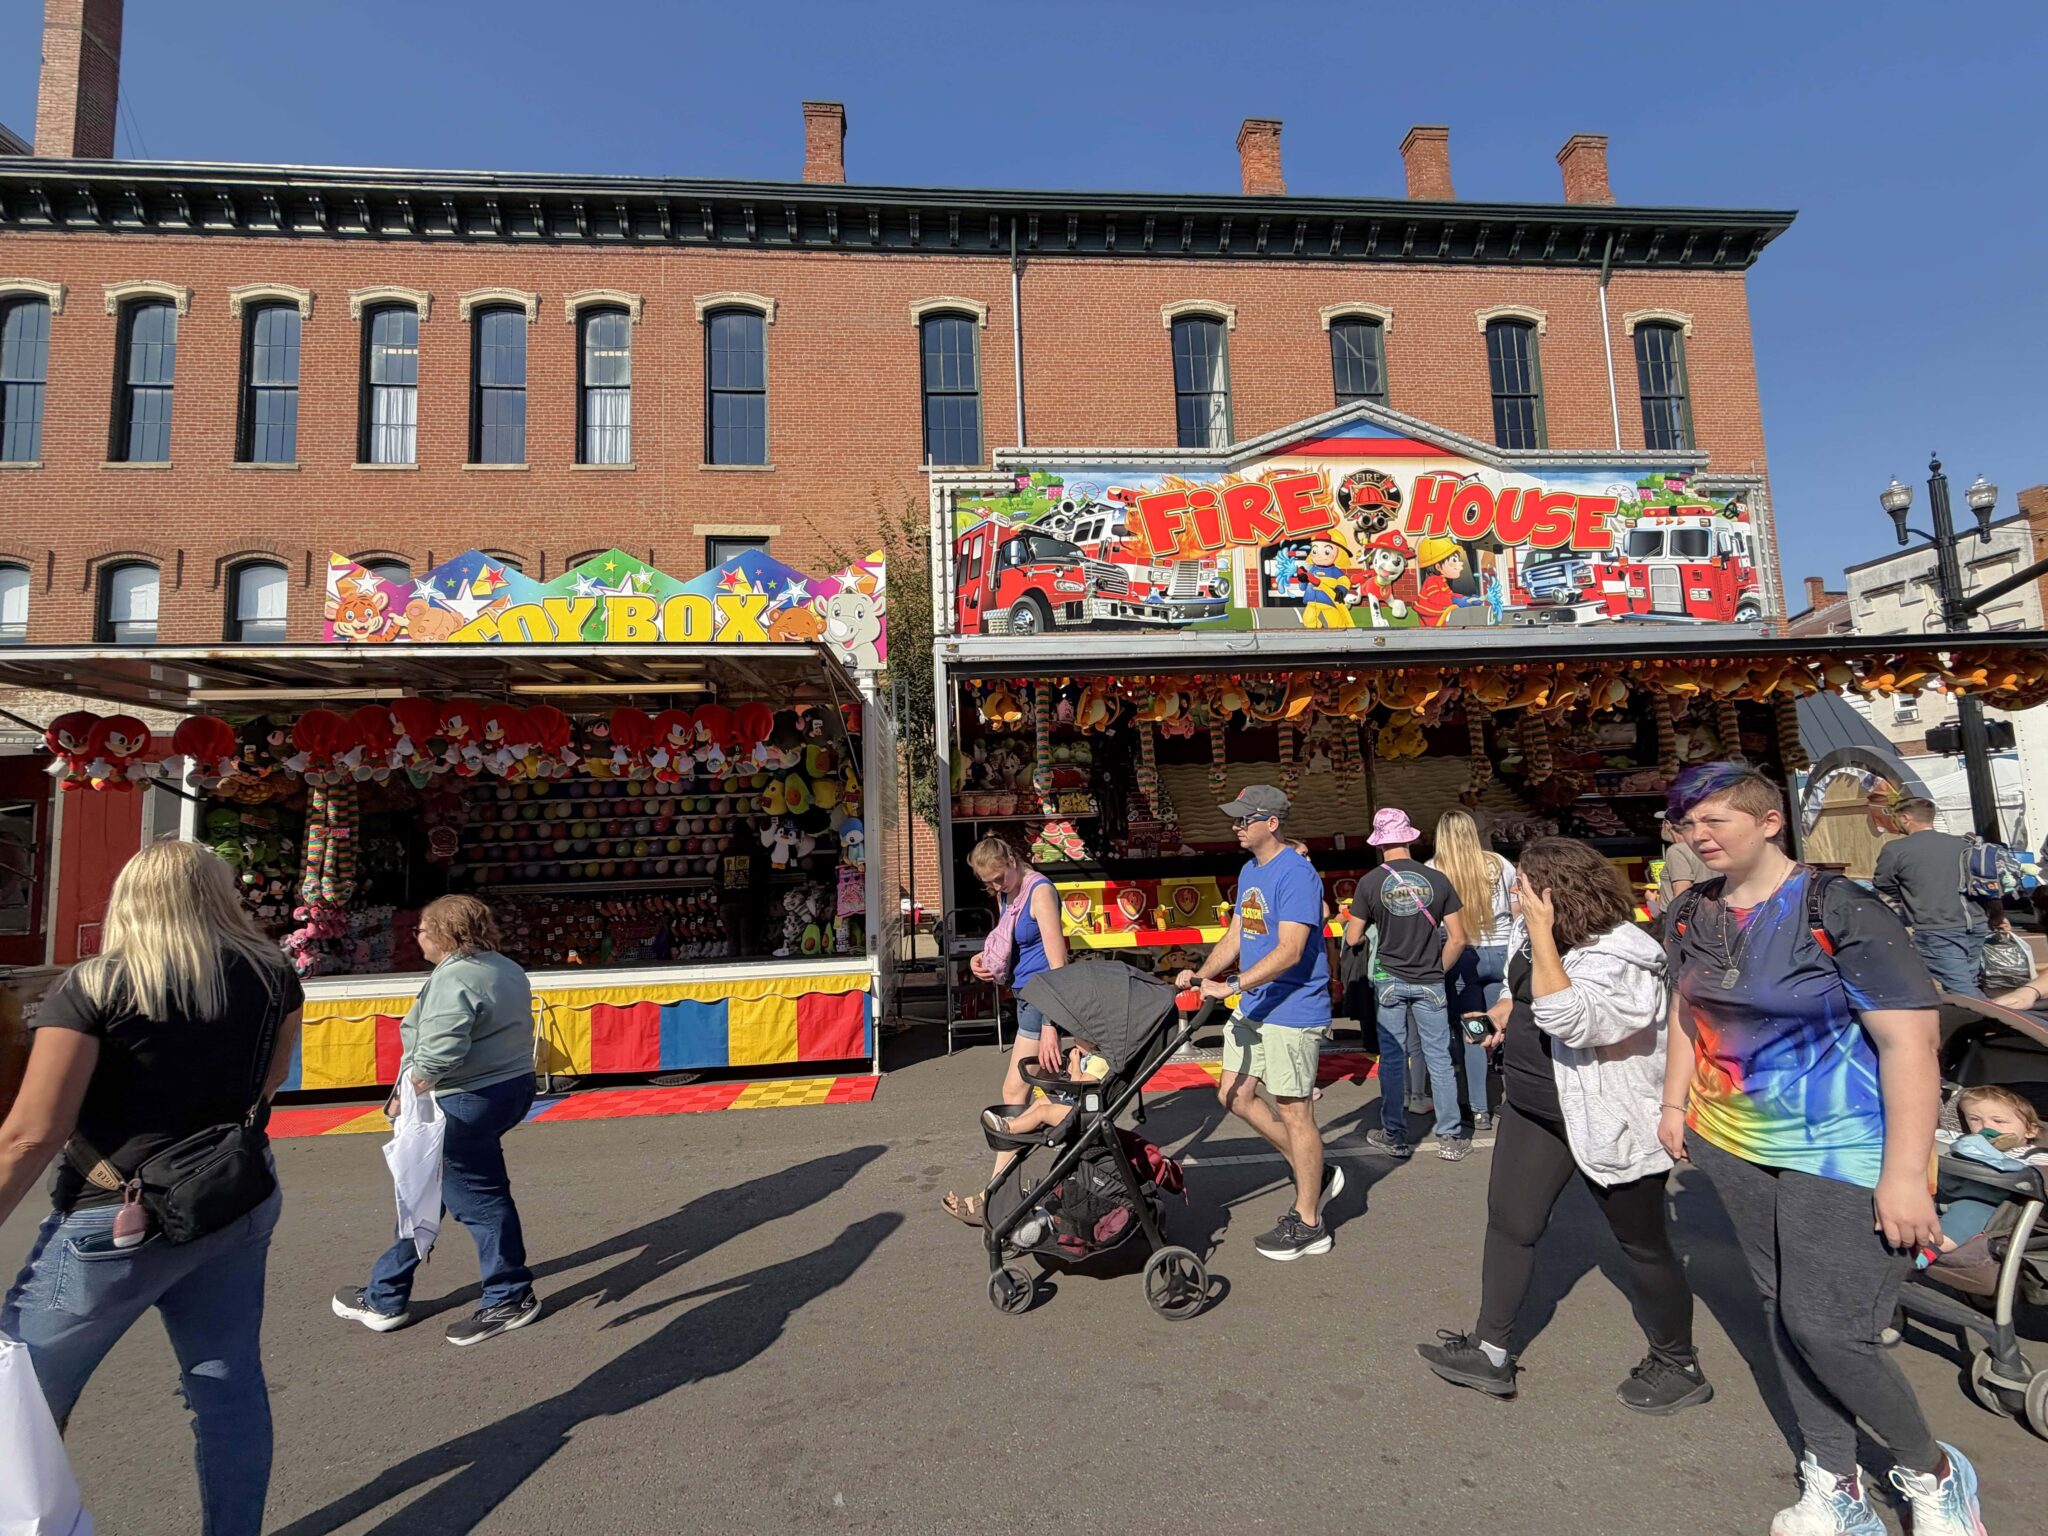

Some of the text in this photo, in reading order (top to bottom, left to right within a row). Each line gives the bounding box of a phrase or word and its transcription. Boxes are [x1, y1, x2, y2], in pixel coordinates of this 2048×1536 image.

[1355, 473, 1380, 481] FIRE
[1404, 476, 1619, 551] HOUSE
[604, 593, 769, 642] BOX
